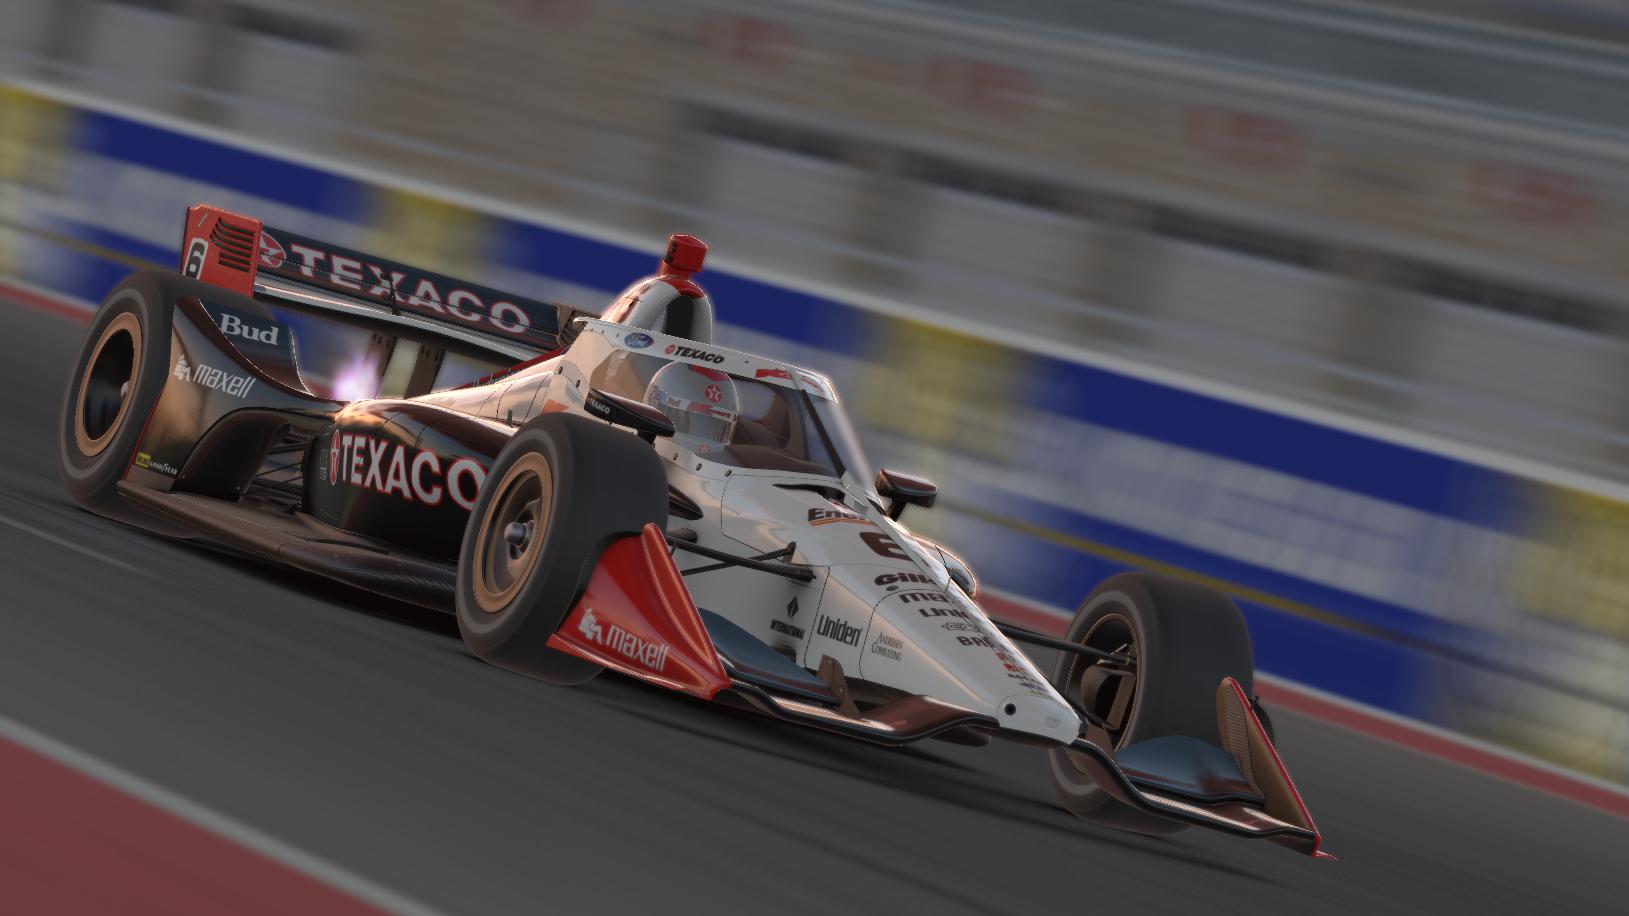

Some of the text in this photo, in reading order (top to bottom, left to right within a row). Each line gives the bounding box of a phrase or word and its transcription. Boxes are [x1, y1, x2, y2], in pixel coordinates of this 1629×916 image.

[185, 238, 208, 280] 6
[289, 242, 532, 335] TEXACO
[220, 313, 279, 346] Bud
[675, 346, 725, 364] TEXACO
[193, 363, 257, 400] maxell
[341, 432, 491, 512] TEXACO
[874, 572, 934, 586] Gill
[604, 624, 671, 673] maxell
[816, 614, 862, 647] Uniden
